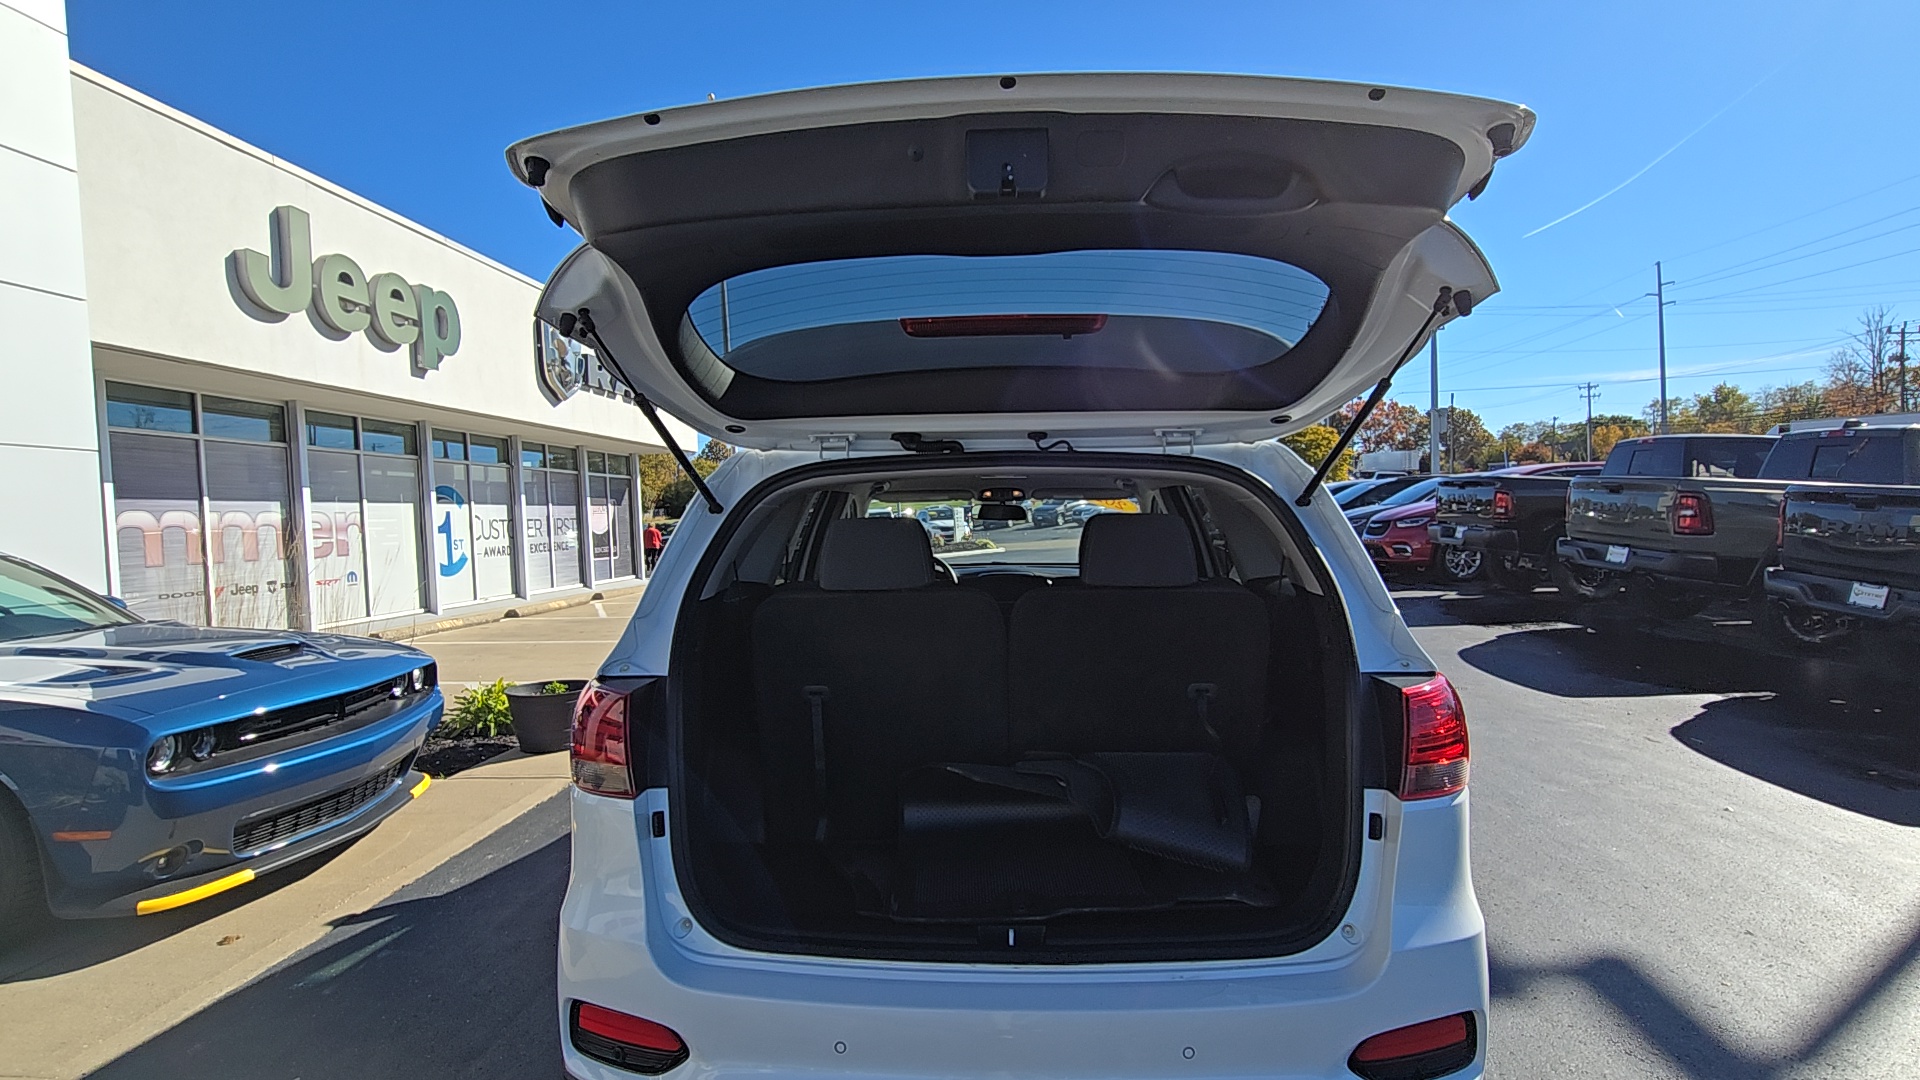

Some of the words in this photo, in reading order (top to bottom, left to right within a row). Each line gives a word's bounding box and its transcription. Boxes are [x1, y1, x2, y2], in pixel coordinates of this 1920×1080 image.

[229, 205, 461, 373] Jeep
[1589, 501, 1638, 512] RAM
[475, 514, 543, 541] CUSTOER
[546, 514, 577, 538] IRST
[1821, 519, 1908, 539] RAM
[530, 541, 569, 554] EXCELENCE
[315, 578, 341, 587] SRT
[230, 583, 259, 596] Jeep
